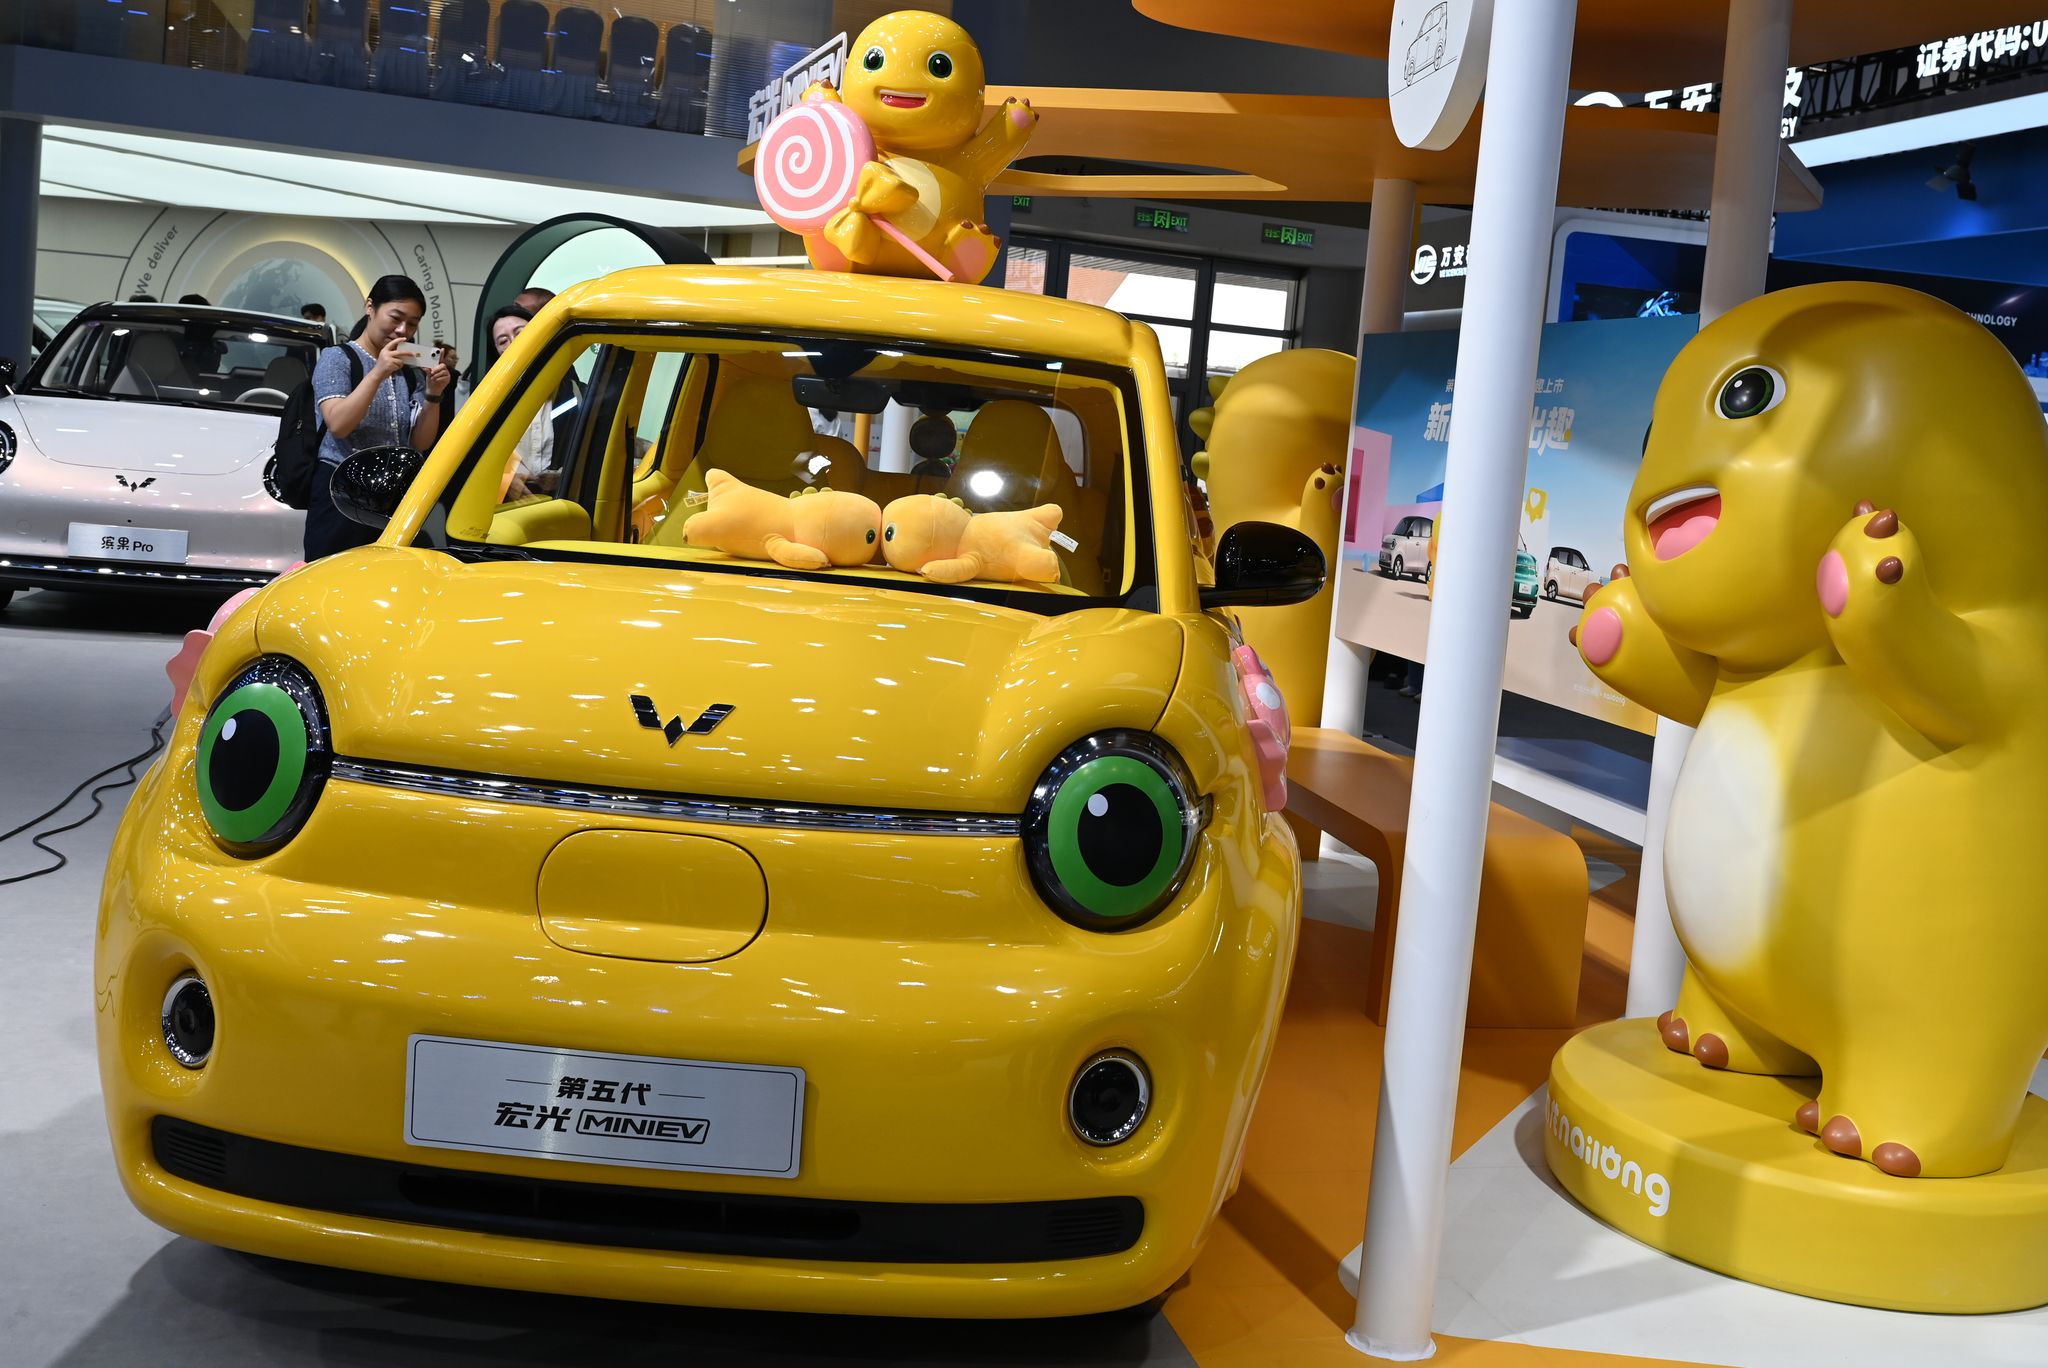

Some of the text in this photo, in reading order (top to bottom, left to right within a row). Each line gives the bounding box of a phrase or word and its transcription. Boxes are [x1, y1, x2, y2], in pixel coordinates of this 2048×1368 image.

[1013, 196, 1031, 207] EXIT
[1171, 216, 1188, 226] EXIT
[1297, 232, 1313, 242] EXIT
[135, 224, 179, 294] We deliver
[413, 244, 435, 291] Caring
[101, 536, 154, 553] 缤果 Pro
[556, 1076, 652, 1106] 第五代
[493, 1101, 705, 1140] 宏光 MINIEV
